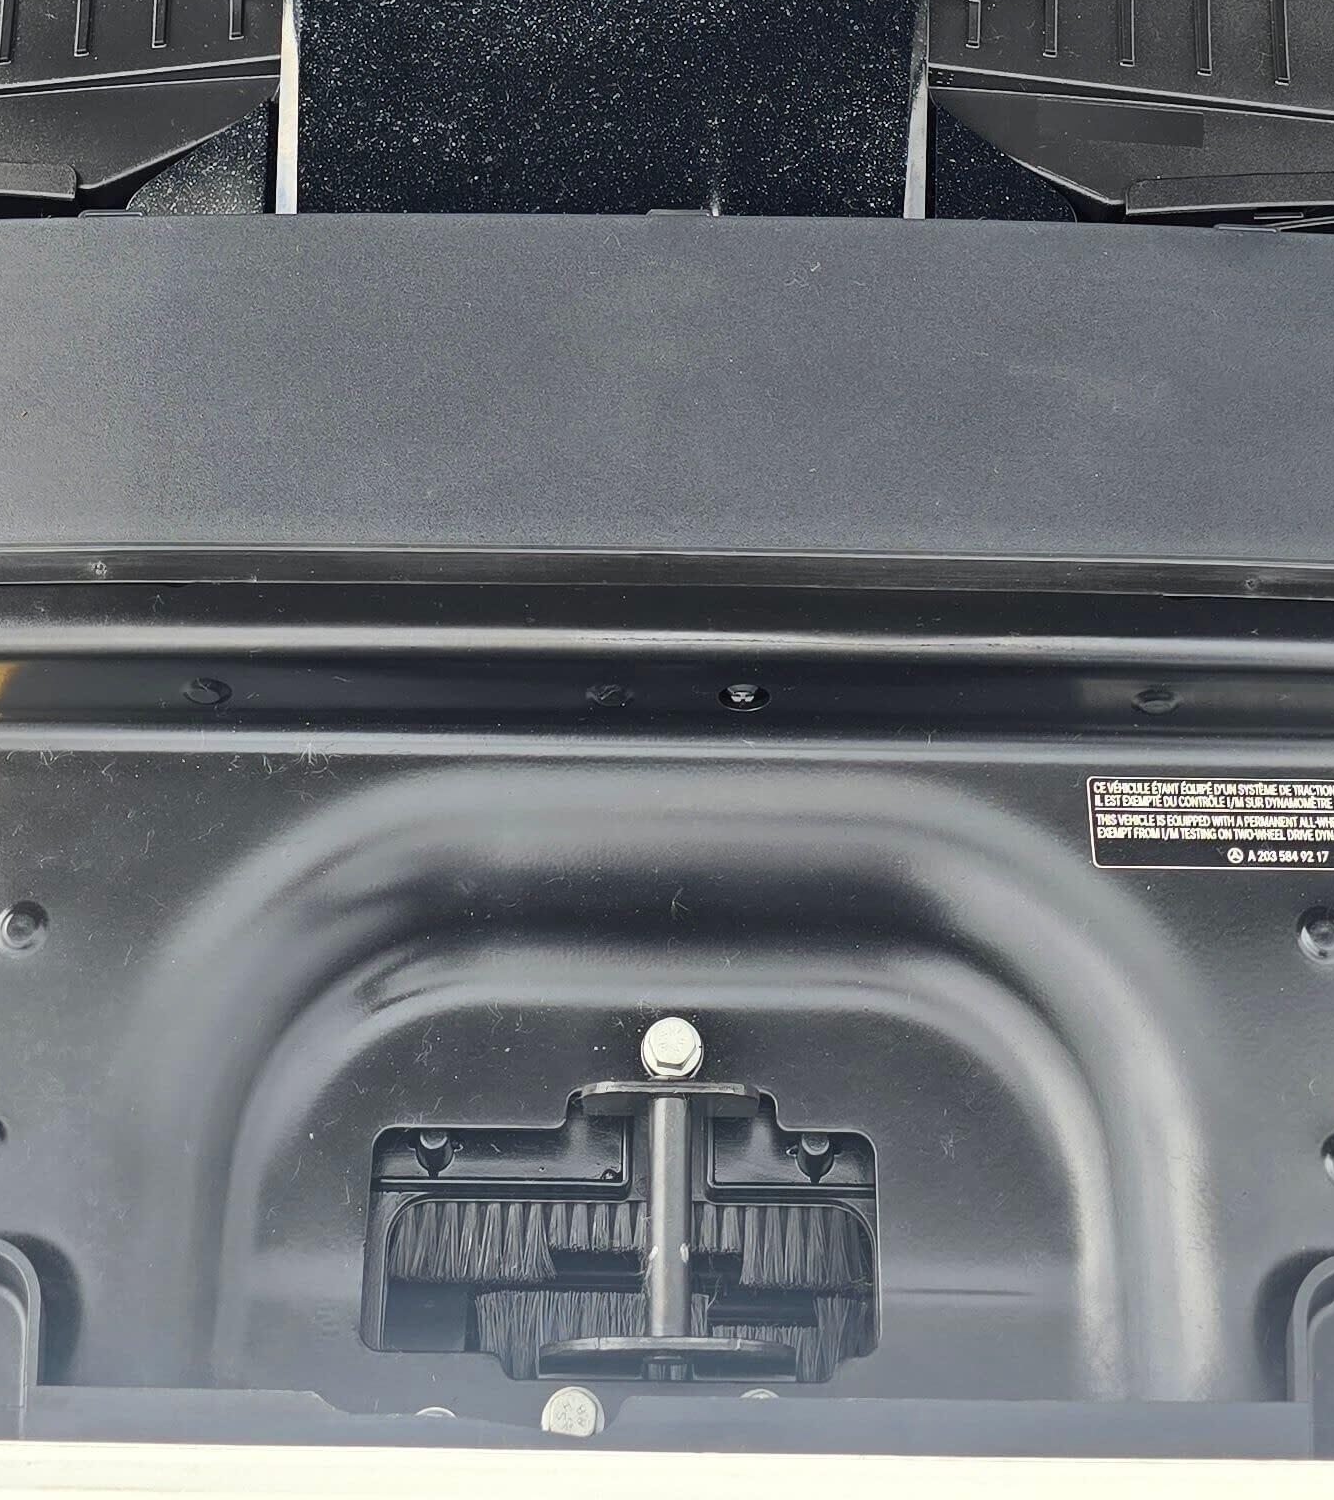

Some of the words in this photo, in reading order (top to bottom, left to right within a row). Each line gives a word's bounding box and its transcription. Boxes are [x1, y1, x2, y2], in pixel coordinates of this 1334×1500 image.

[1093, 782, 1107, 794] CE
[1107, 780, 1151, 795] VÉHICULE
[1279, 785, 1292, 797] DE
[1105, 796, 1121, 807] EST
[1163, 797, 1178, 807] DU
[1246, 798, 1265, 809] SUR
[1096, 814, 1118, 826] THIS
[1118, 814, 1156, 826] VEHICLE
[1156, 815, 1167, 826] IS
[1167, 815, 1211, 827] EQUIPPED
[1212, 816, 1235, 827] WITH
[1244, 816, 1298, 828] PERMANENT
[1097, 827, 1133, 839] EXEMPT
[1134, 827, 1161, 839] FROM
[1180, 828, 1217, 840] TESTING
[1217, 828, 1233, 840] ON
[1287, 829, 1314, 841] DRIVE
[1247, 851, 1256, 862] A
[1257, 851, 1278, 862] 203
[1279, 851, 1299, 862] 584
[1301, 851, 1315, 863] 92
[1316, 851, 1330, 863] 17
